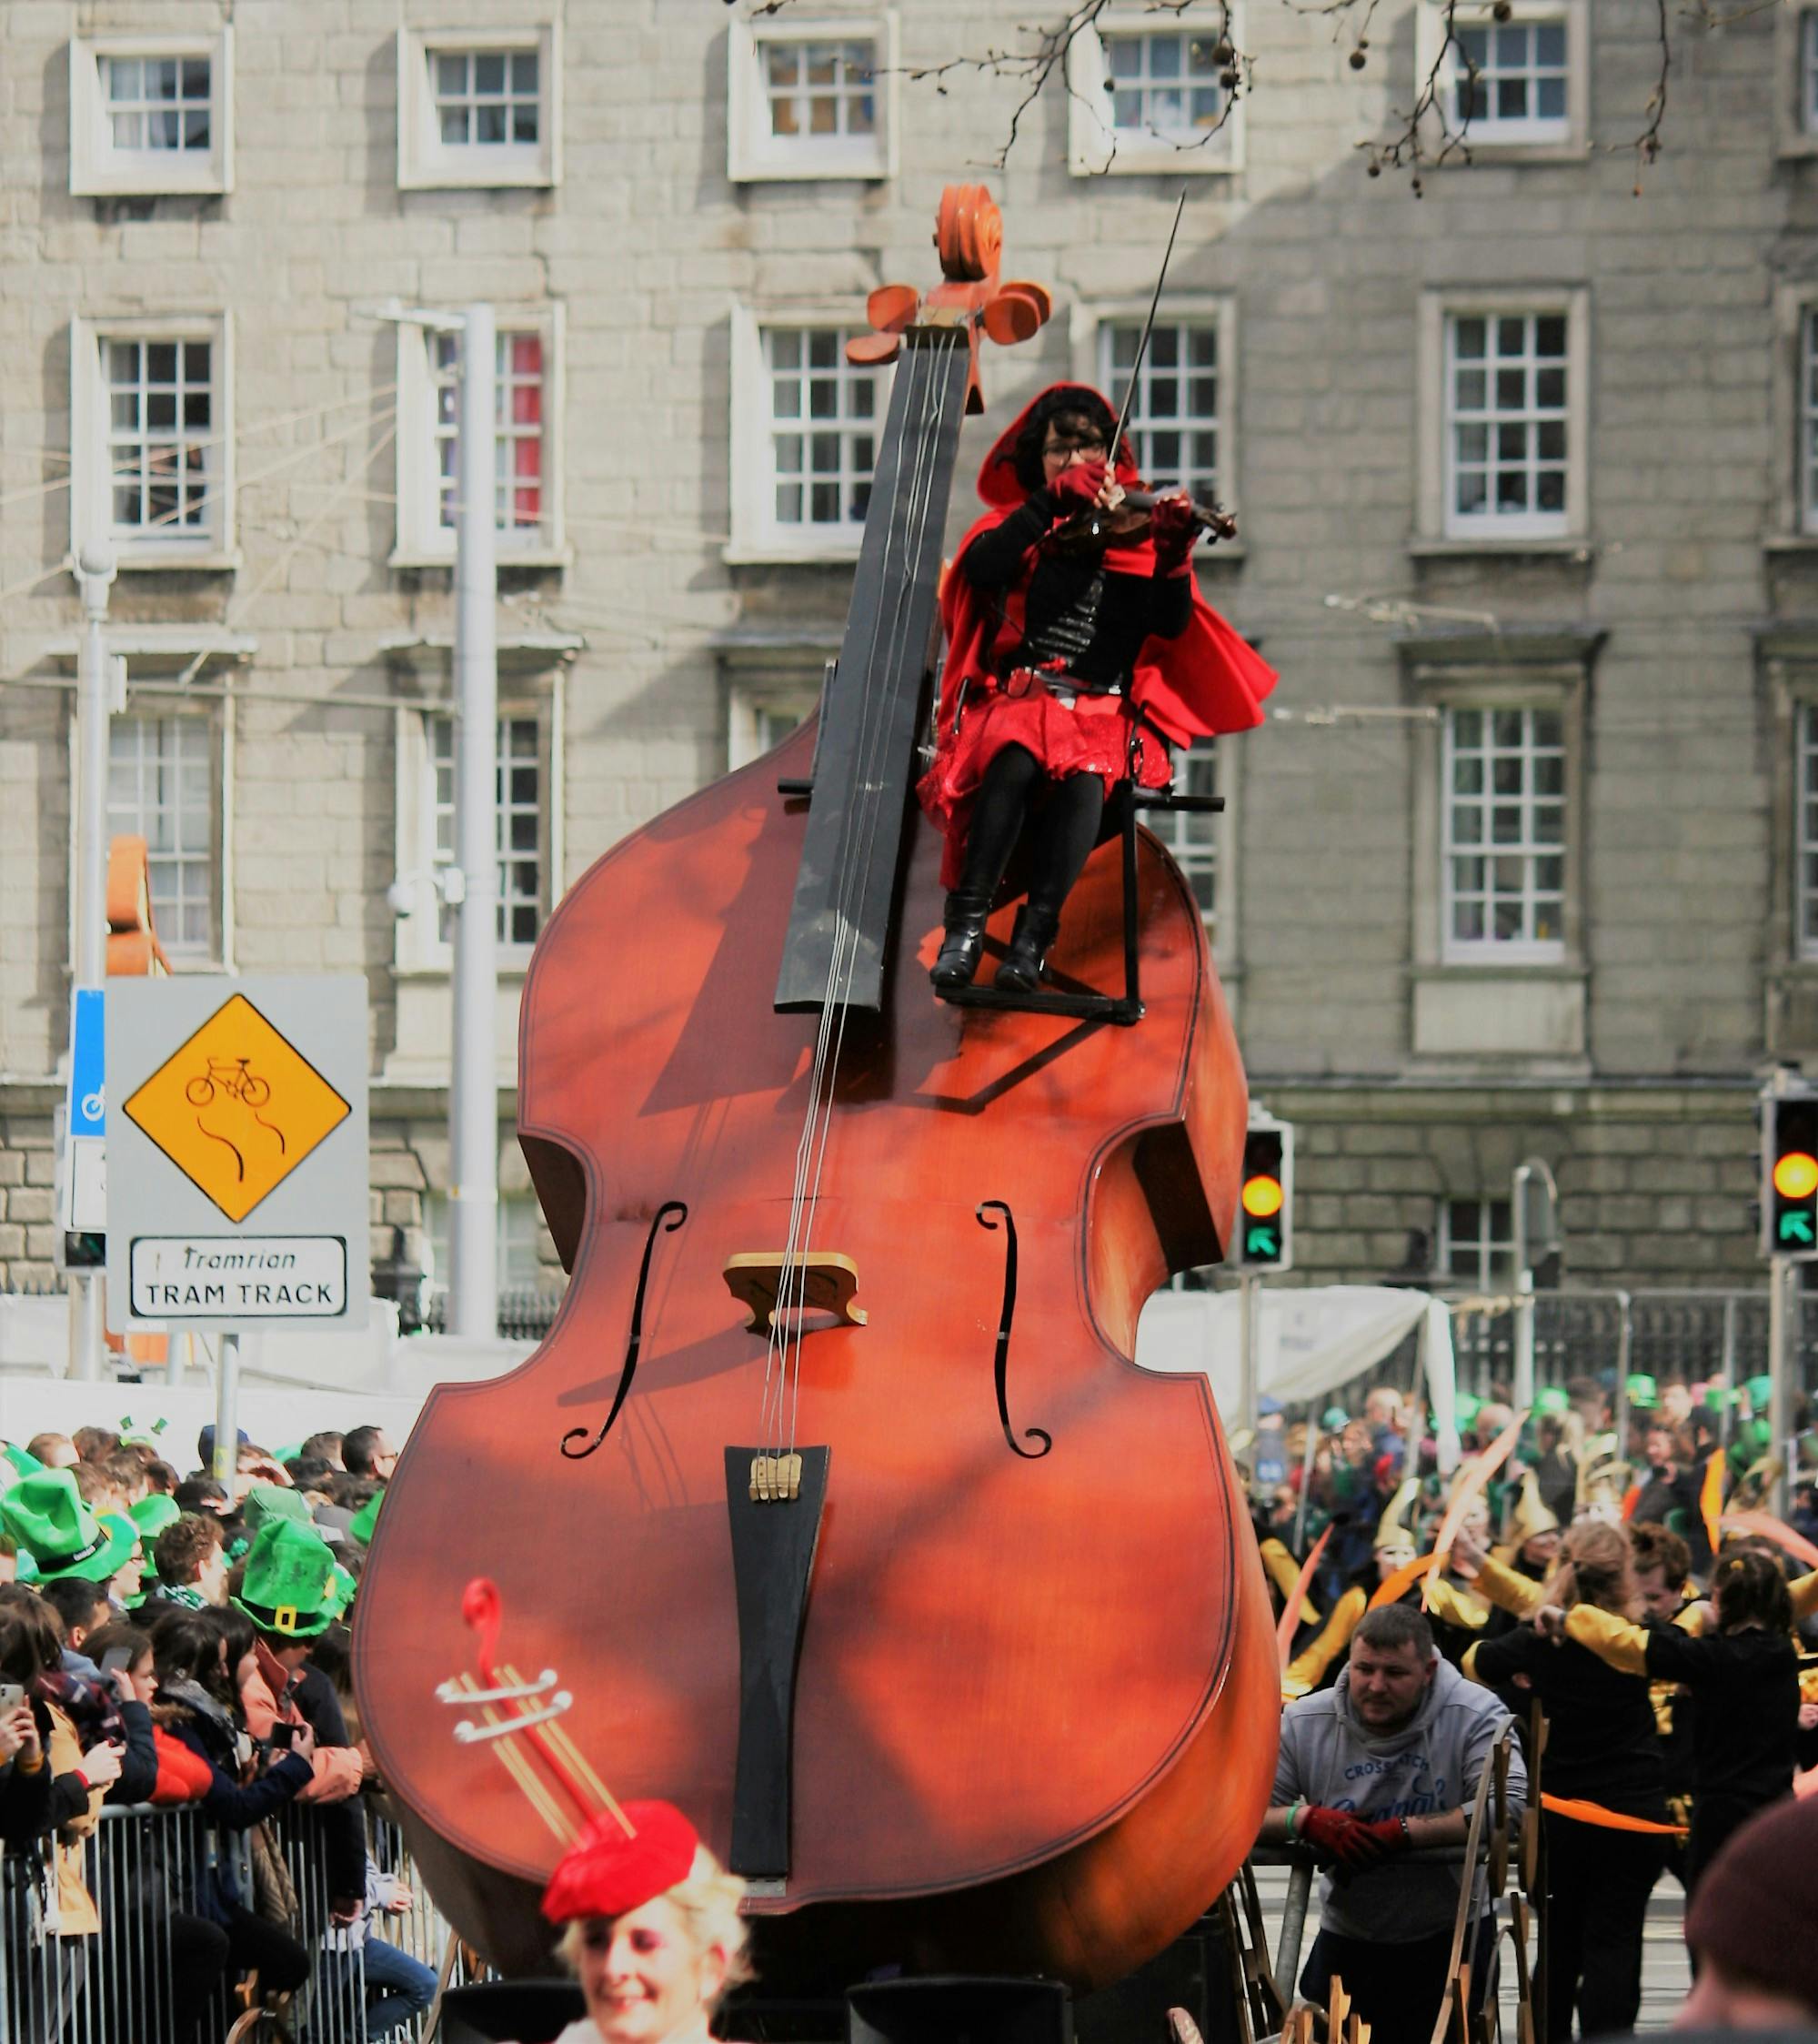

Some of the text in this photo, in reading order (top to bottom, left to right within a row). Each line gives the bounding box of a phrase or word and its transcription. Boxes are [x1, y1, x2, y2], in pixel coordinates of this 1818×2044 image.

[184, 1246, 296, 1269] Tramrian
[146, 1284, 333, 1304] TRAM TRACK
